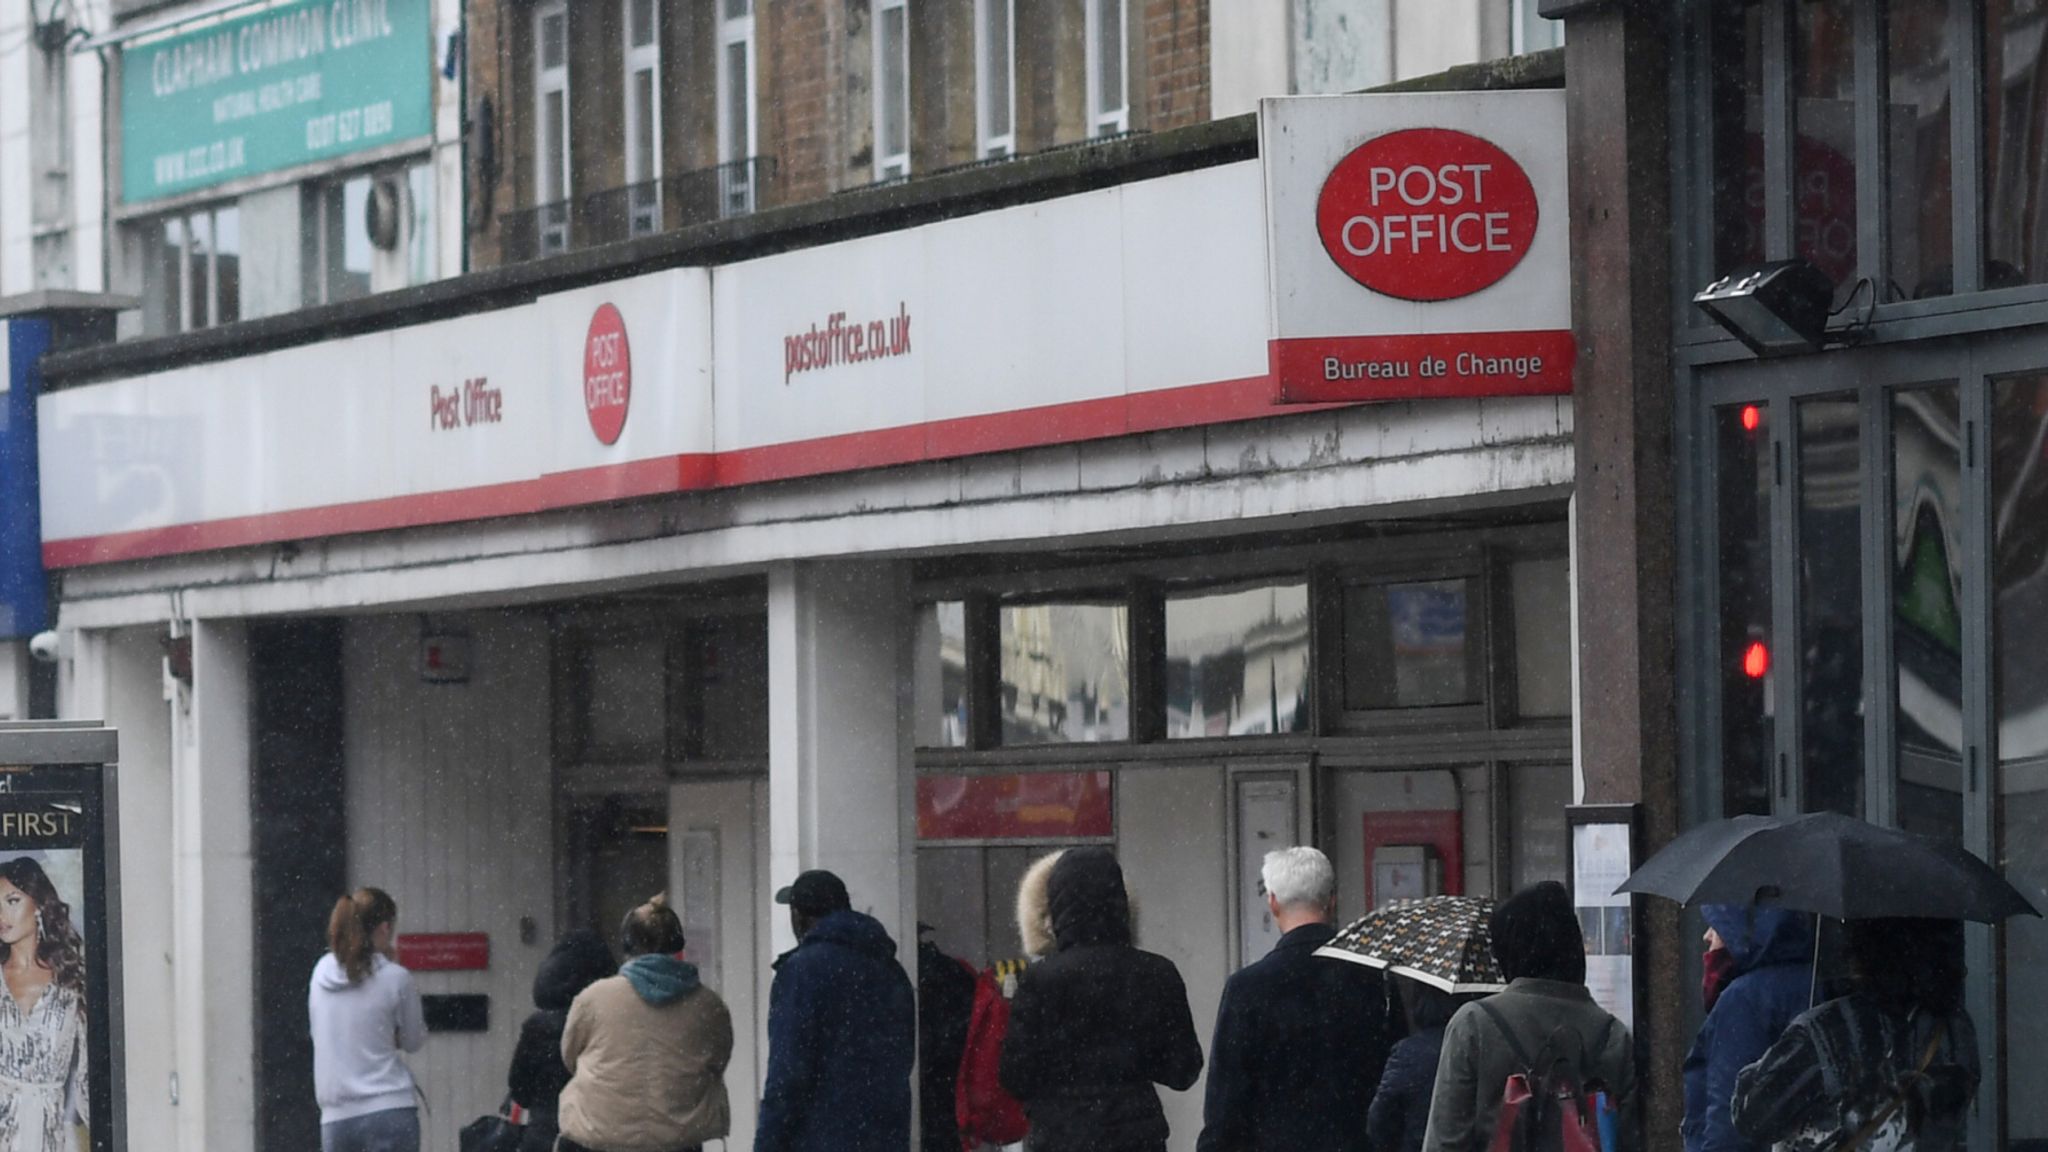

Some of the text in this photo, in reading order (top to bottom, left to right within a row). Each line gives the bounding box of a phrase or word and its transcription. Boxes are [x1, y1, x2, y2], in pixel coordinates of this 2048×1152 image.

[153, 0, 392, 97] CLAPHAM COMMON CLINIC
[1369, 164, 1492, 206] POST
[1341, 212, 1513, 256] OFFICE
[591, 330, 621, 368] POST
[784, 301, 912, 385] postoffice.co.uk
[1324, 352, 1543, 381] Bureau de Change
[430, 376, 503, 432] Post Office
[586, 373, 625, 411] OFFICE
[2, 811, 71, 837] FIRST
